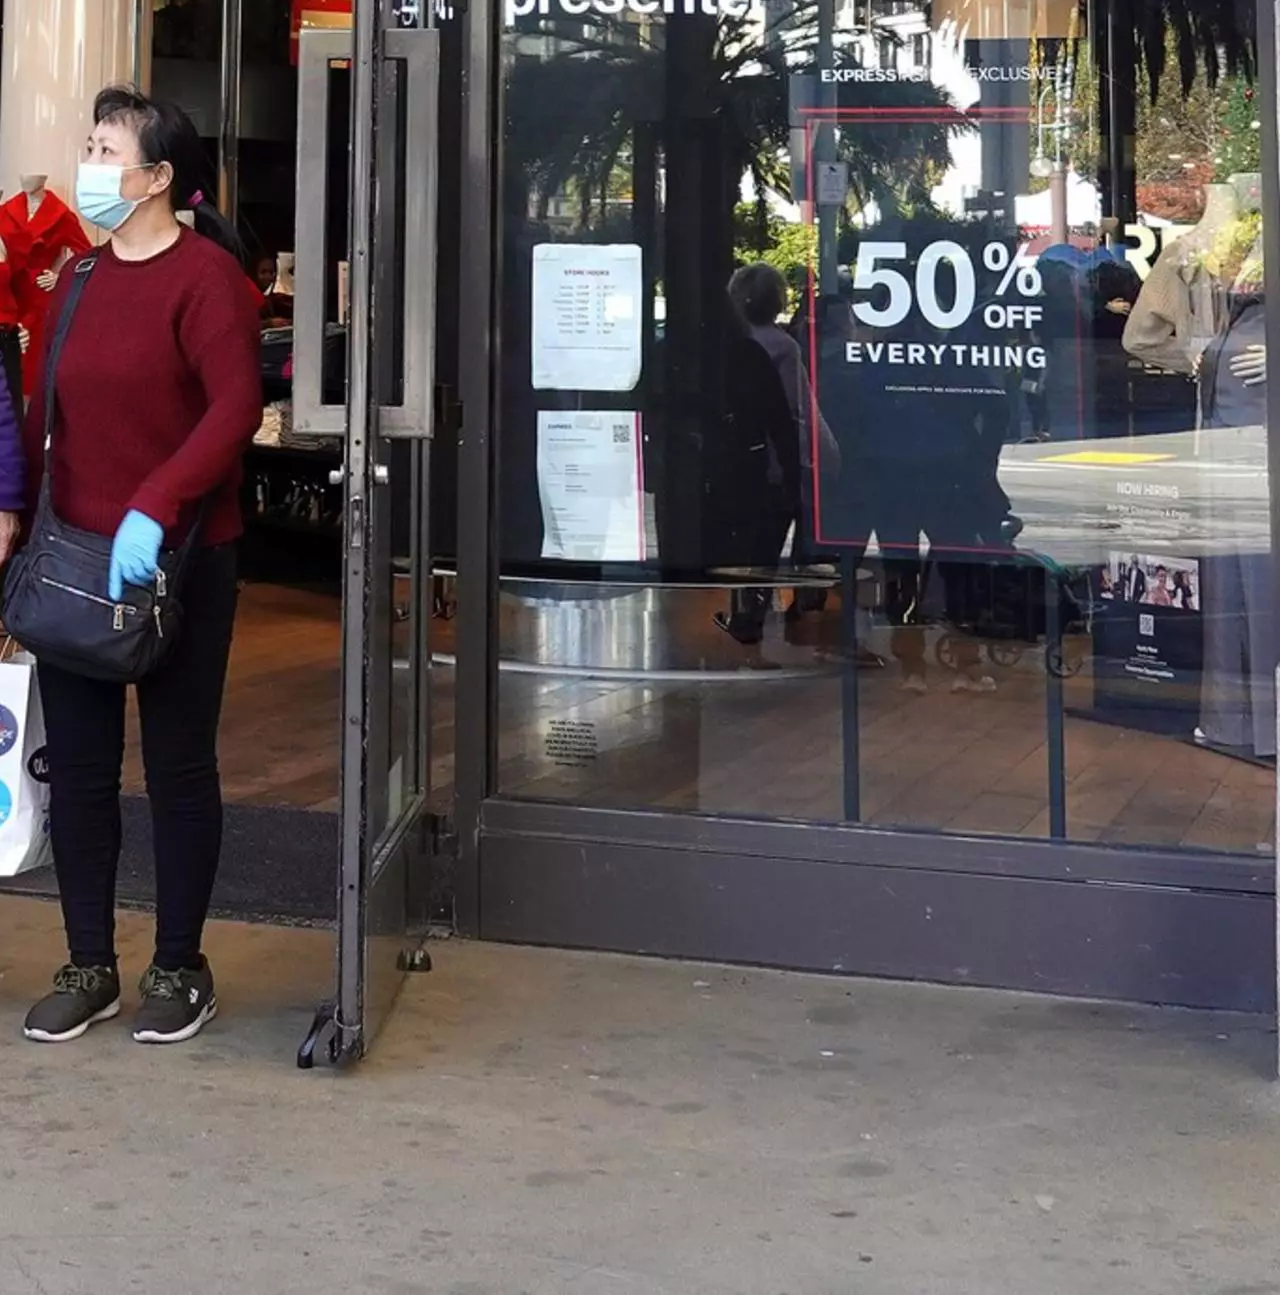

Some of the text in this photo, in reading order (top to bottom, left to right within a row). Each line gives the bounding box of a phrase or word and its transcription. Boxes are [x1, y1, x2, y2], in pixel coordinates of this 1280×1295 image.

[983, 305, 1043, 329] OFF
[845, 342, 1047, 369] EVERYTHING
[1116, 481, 1142, 496] NOW
